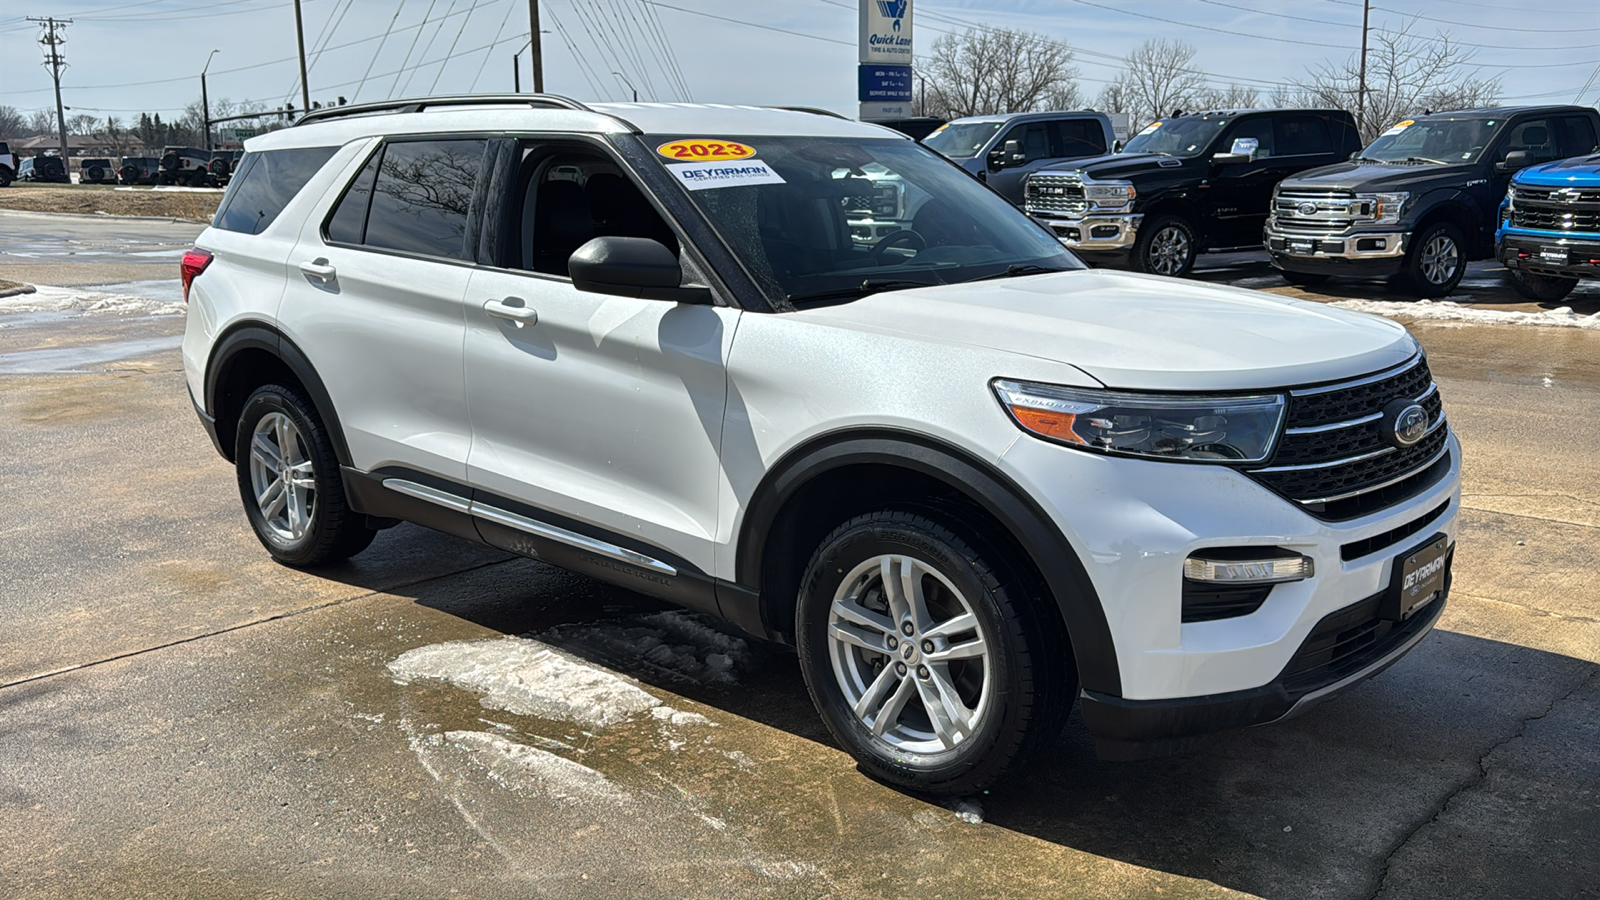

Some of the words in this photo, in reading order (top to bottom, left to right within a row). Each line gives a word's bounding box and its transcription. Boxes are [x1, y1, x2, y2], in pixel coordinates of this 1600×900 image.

[869, 33, 895, 45] Quick
[895, 35, 911, 46] Lane
[670, 143, 748, 157] 2023
[682, 166, 768, 179] DEYARMAN
[580, 554, 671, 586] EXPLORER
[1403, 553, 1446, 590] DEYARMAN
